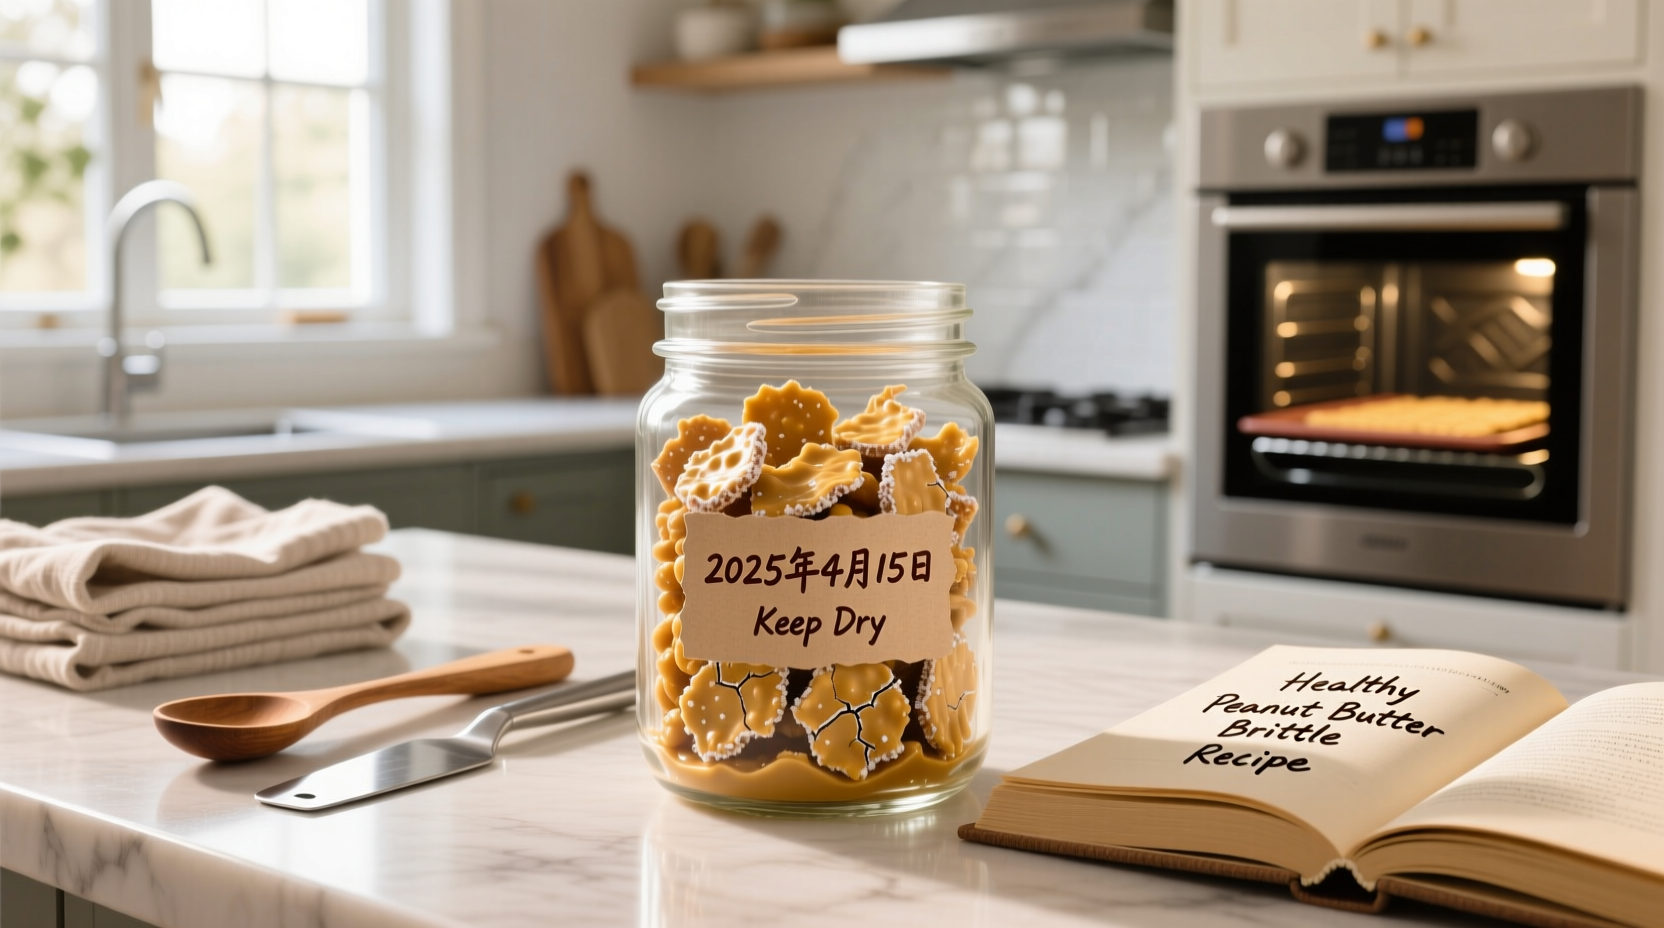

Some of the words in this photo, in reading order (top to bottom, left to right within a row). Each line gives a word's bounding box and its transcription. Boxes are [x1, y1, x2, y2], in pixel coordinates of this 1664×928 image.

[704, 546, 932, 594] 2025年4月15日
[753, 605, 822, 647] Keep
[833, 606, 886, 646] Dry
[1279, 672, 1420, 706] Healthy
[1202, 693, 1323, 718] Peanut
[1328, 701, 1445, 738] Butter
[1217, 719, 1342, 746] Brittle
[1183, 743, 1311, 776] Recipe
